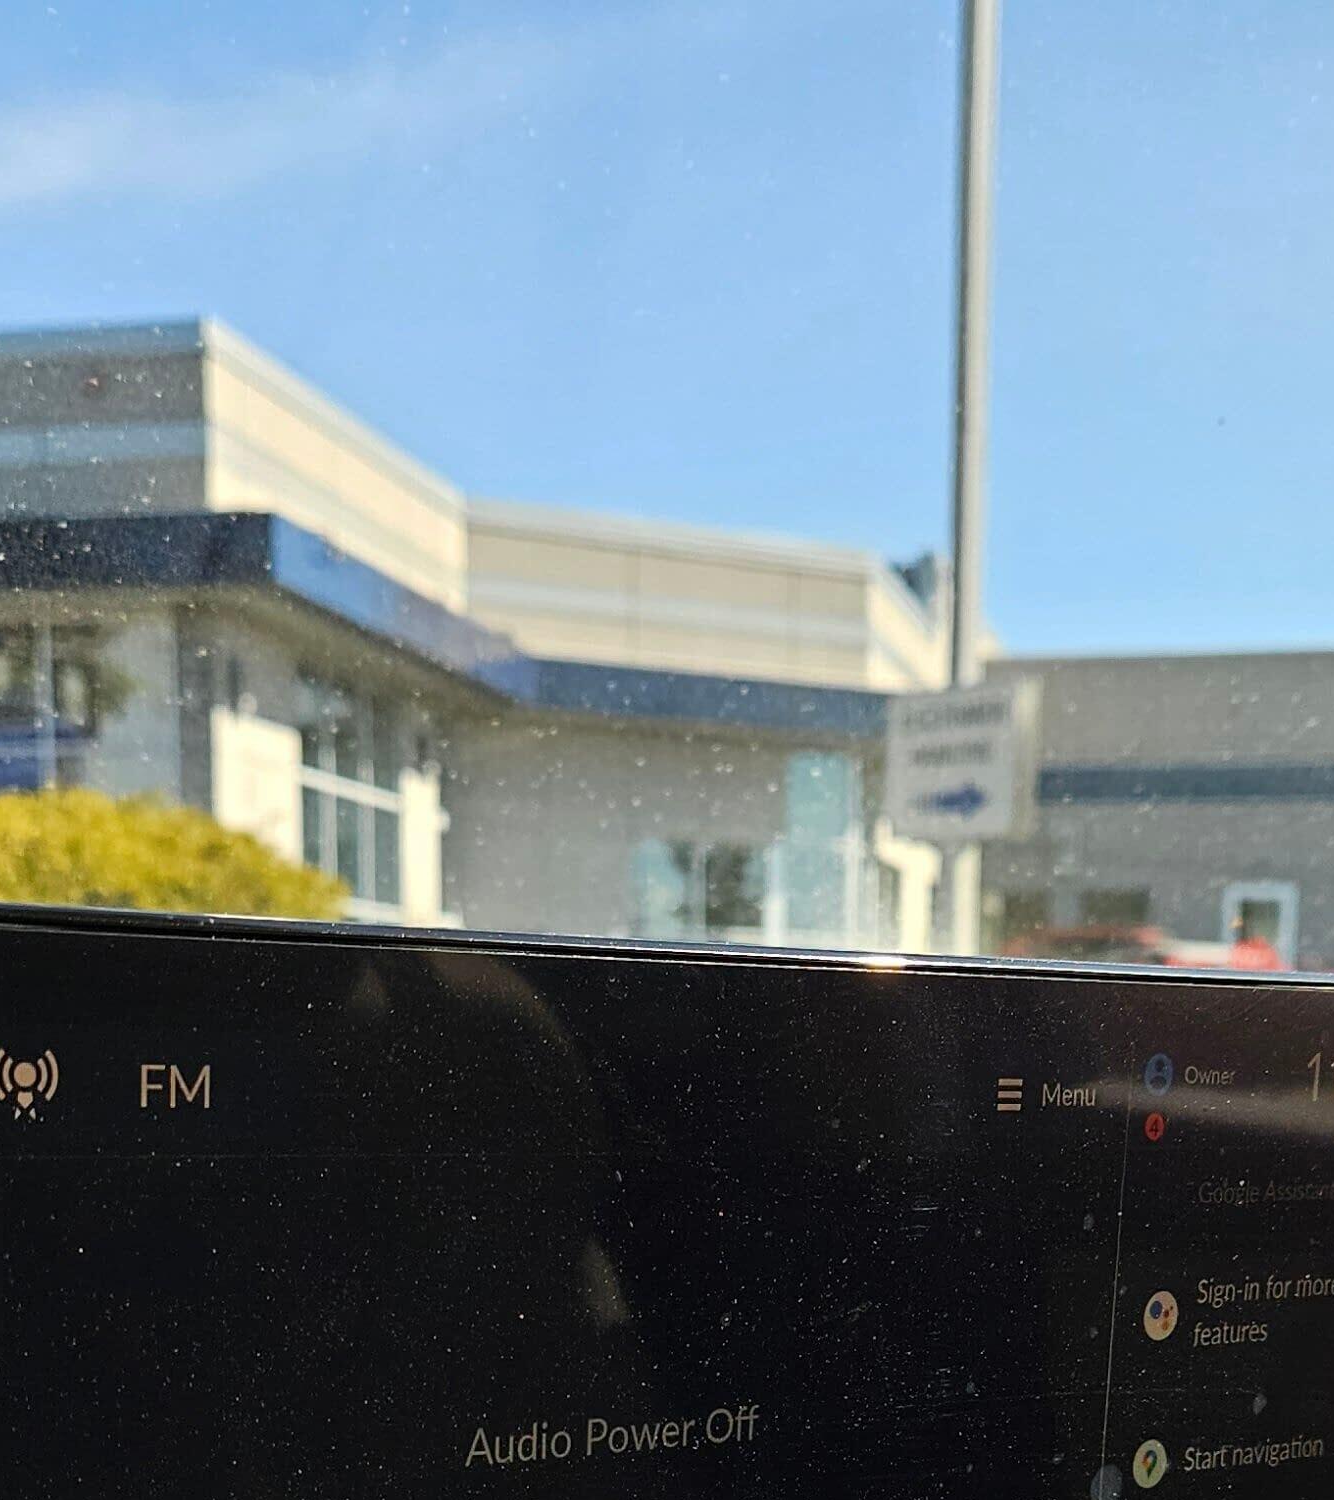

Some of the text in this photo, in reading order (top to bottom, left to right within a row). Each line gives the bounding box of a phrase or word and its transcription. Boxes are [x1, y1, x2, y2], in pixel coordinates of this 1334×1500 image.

[140, 1064, 212, 1109] FM
[1184, 1065, 1236, 1087] Owner
[1041, 1081, 1096, 1107] Menu
[1196, 1277, 1261, 1305] Sign-in
[1265, 1273, 1291, 1300] for
[1192, 1321, 1268, 1349] features
[465, 1403, 761, 1468] Audio Power Off
[1183, 1435, 1324, 1472] Start navigation
